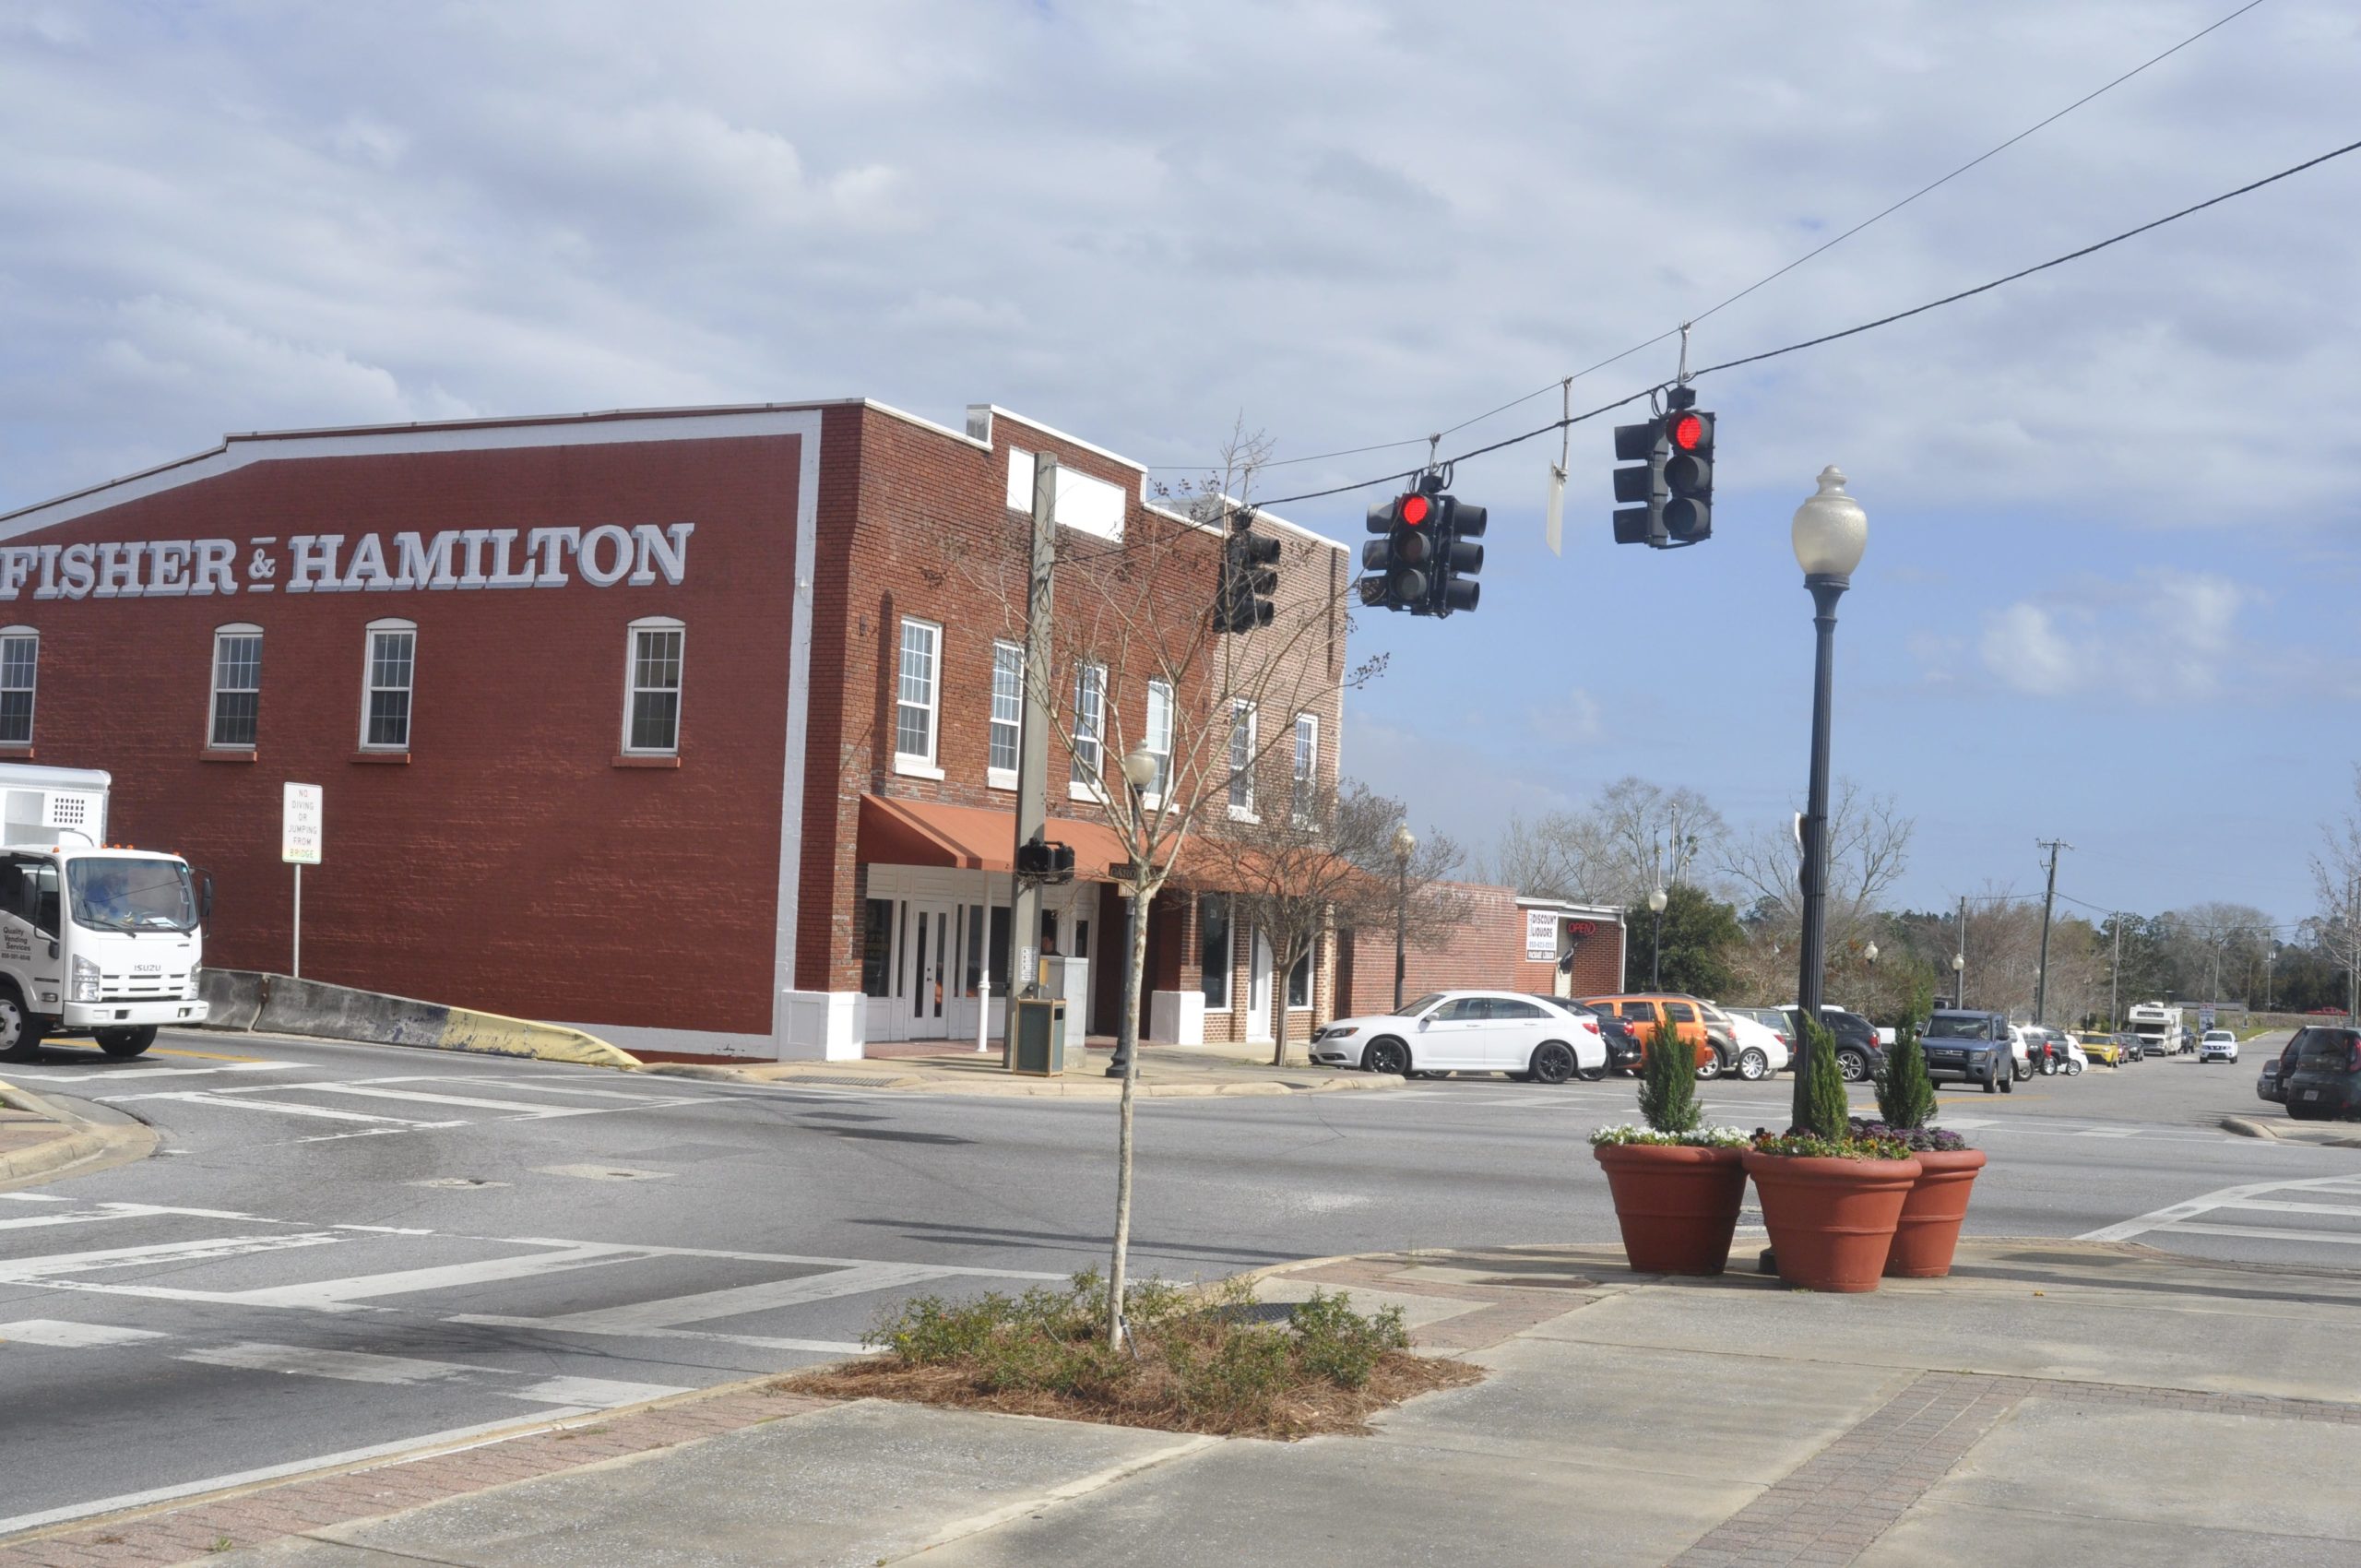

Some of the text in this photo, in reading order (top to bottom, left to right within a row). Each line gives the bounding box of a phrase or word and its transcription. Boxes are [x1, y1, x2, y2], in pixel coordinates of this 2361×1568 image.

[0, 523, 694, 600] FISHER & HAMILTON
[291, 801, 314, 810] DIVING
[298, 813, 307, 821] OR
[289, 825, 317, 834] JUMPING
[293, 837, 312, 845] FROM
[290, 849, 314, 858] BRIDGE
[1532, 914, 1556, 926] DISCOUNT
[3, 926, 24, 936] Quality
[1532, 927, 1553, 938] LIQUORS
[1568, 922, 1592, 934] OPEN
[5, 934, 28, 944] Vending
[6, 942, 31, 951] Services
